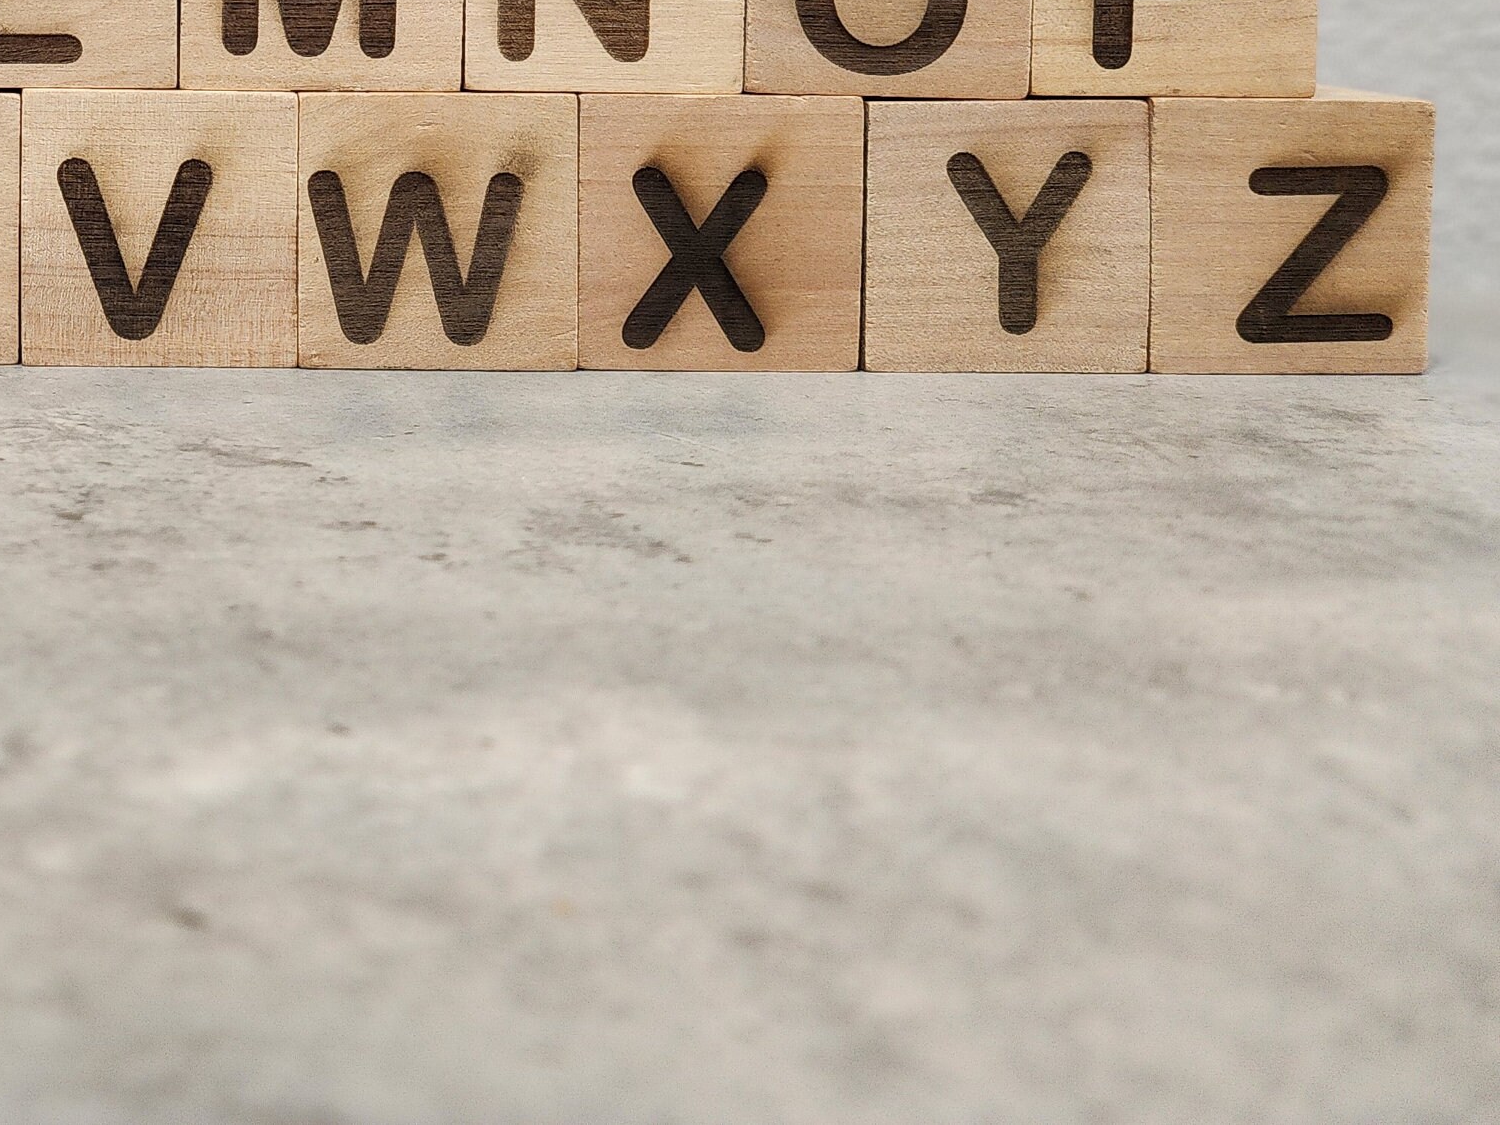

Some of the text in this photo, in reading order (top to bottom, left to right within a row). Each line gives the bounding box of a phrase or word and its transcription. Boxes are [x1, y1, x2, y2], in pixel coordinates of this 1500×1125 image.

[58, 158, 213, 340] V
[308, 170, 524, 346] W
[622, 166, 770, 352] X
[947, 151, 1093, 335] Y
[1236, 166, 1395, 343] Z
